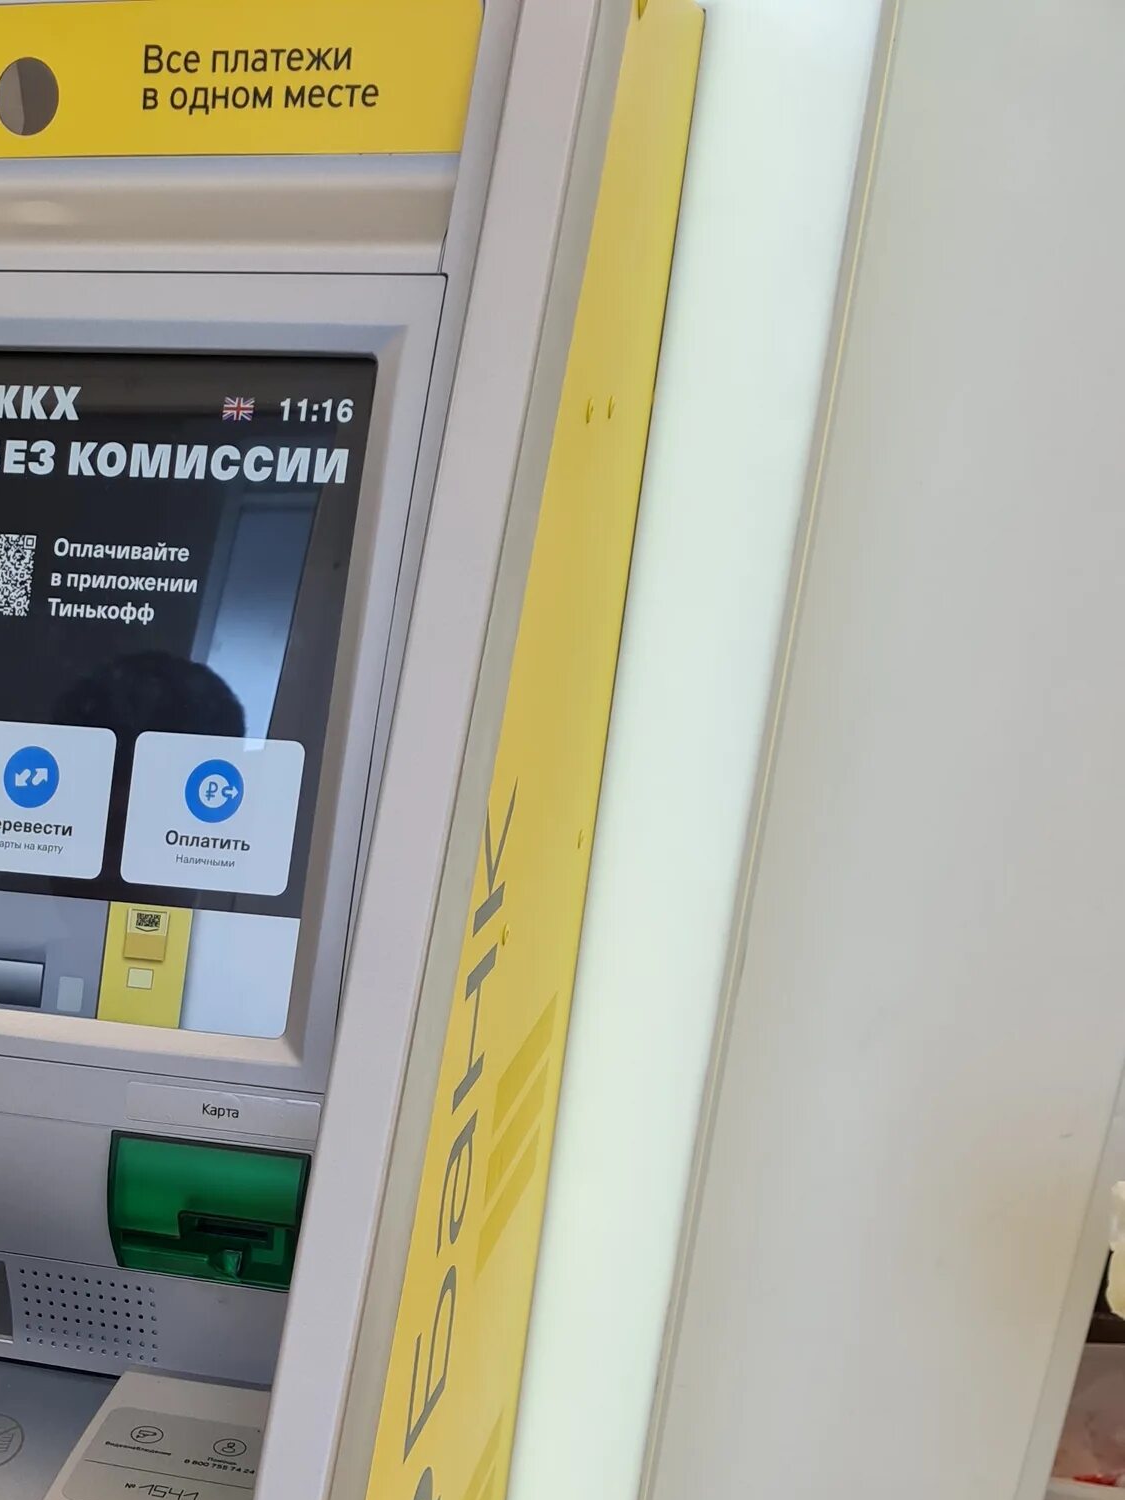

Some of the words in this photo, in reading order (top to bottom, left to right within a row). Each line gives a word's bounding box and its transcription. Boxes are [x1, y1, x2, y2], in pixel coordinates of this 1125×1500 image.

[142, 44, 200, 76] Все
[211, 46, 354, 76] платежи
[142, 87, 159, 110] в
[169, 84, 274, 116] одном
[283, 81, 380, 109] месте
[279, 398, 354, 423] 11:16
[68, 442, 350, 484] КОМИССИИ
[53, 537, 190, 562] Оплачивайте
[50, 574, 61, 588] в
[66, 572, 198, 594] приложении
[48, 598, 155, 625] Тинькофф
[24, 842, 35, 851] на
[36, 843, 64, 855] карту
[165, 830, 251, 852] Оплатить
[175, 854, 236, 869] Наличными
[201, 1103, 240, 1120] Карта
[402, 776, 518, 1463] Банк
